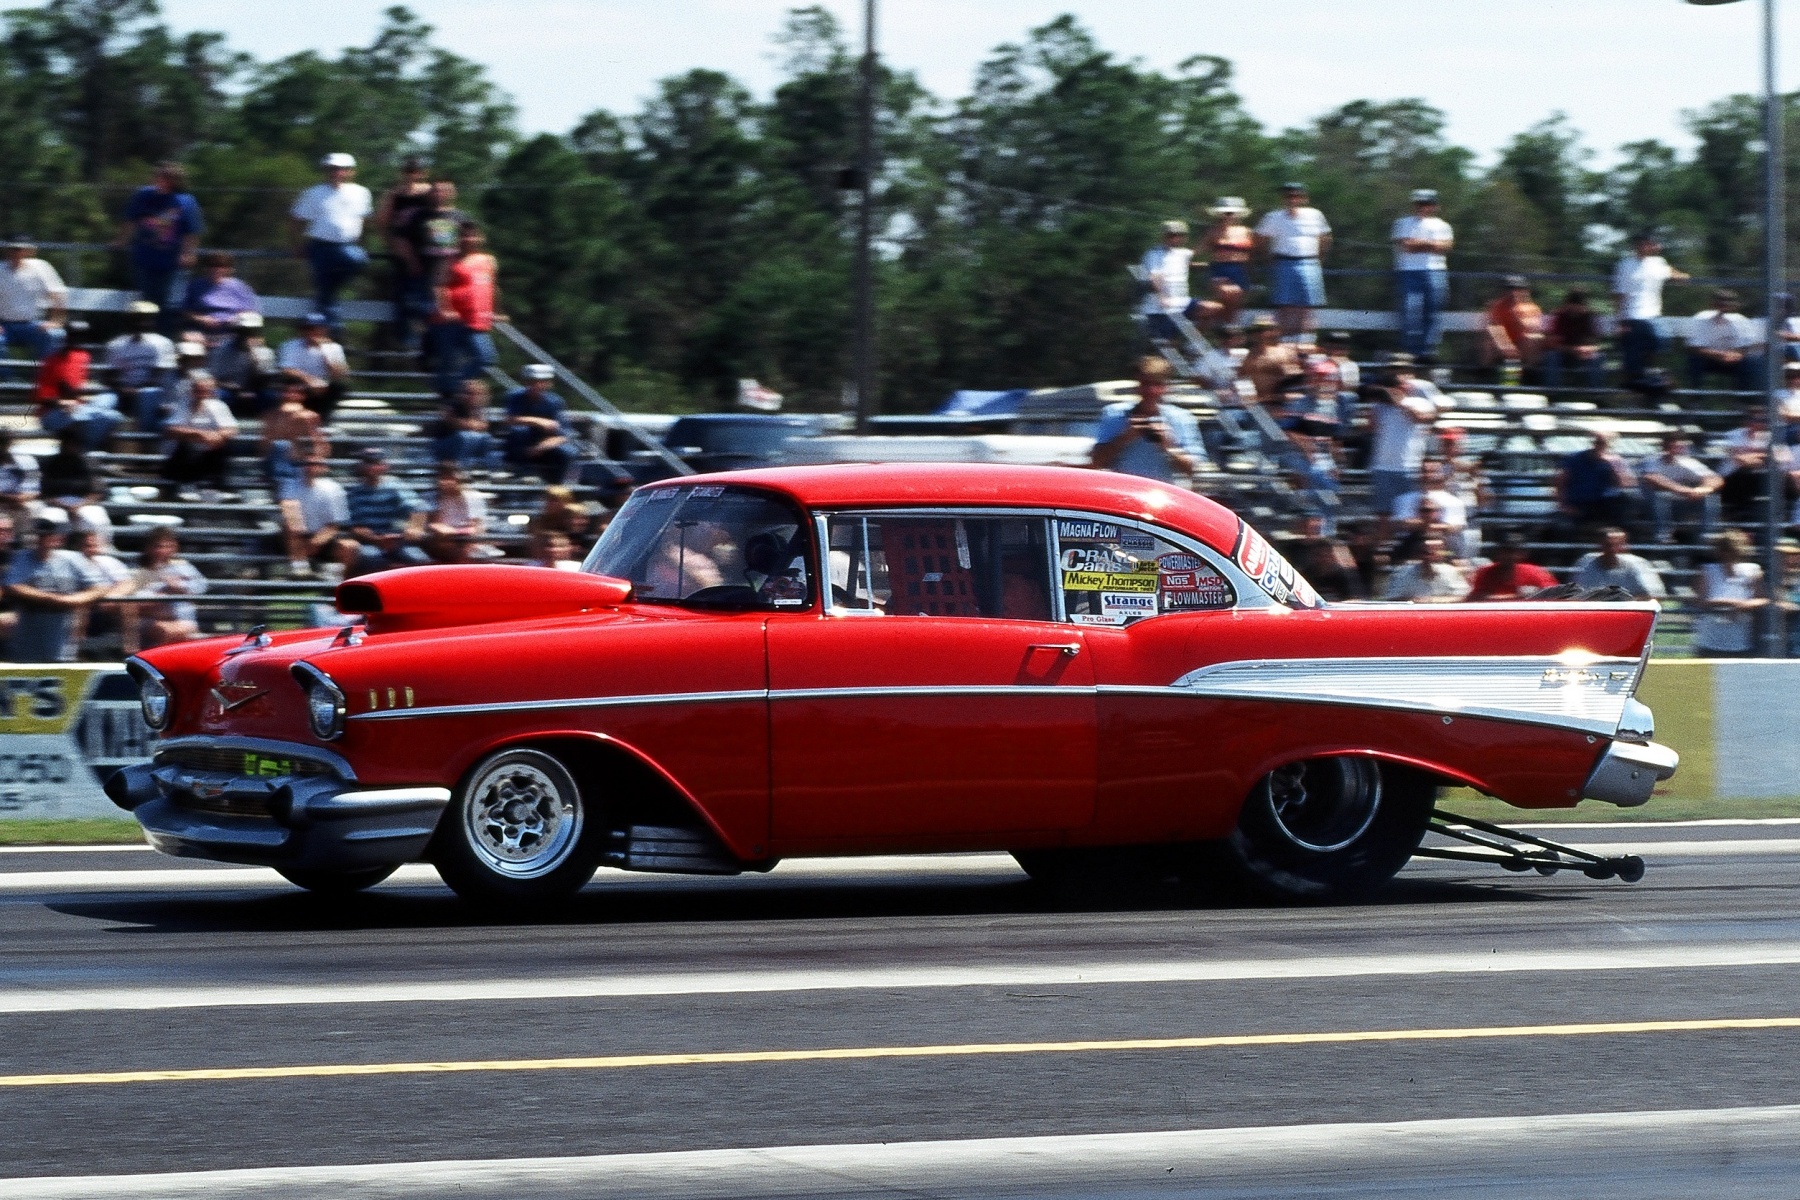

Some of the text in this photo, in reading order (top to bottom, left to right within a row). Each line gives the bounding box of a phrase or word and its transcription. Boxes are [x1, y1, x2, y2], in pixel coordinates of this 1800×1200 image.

[1060, 522, 1118, 538] MAGNAFLOW
[1068, 573, 1154, 589] Mickey Thompson
[1104, 595, 1153, 606] Strange
[1164, 591, 1223, 609] FLOWMASTER
